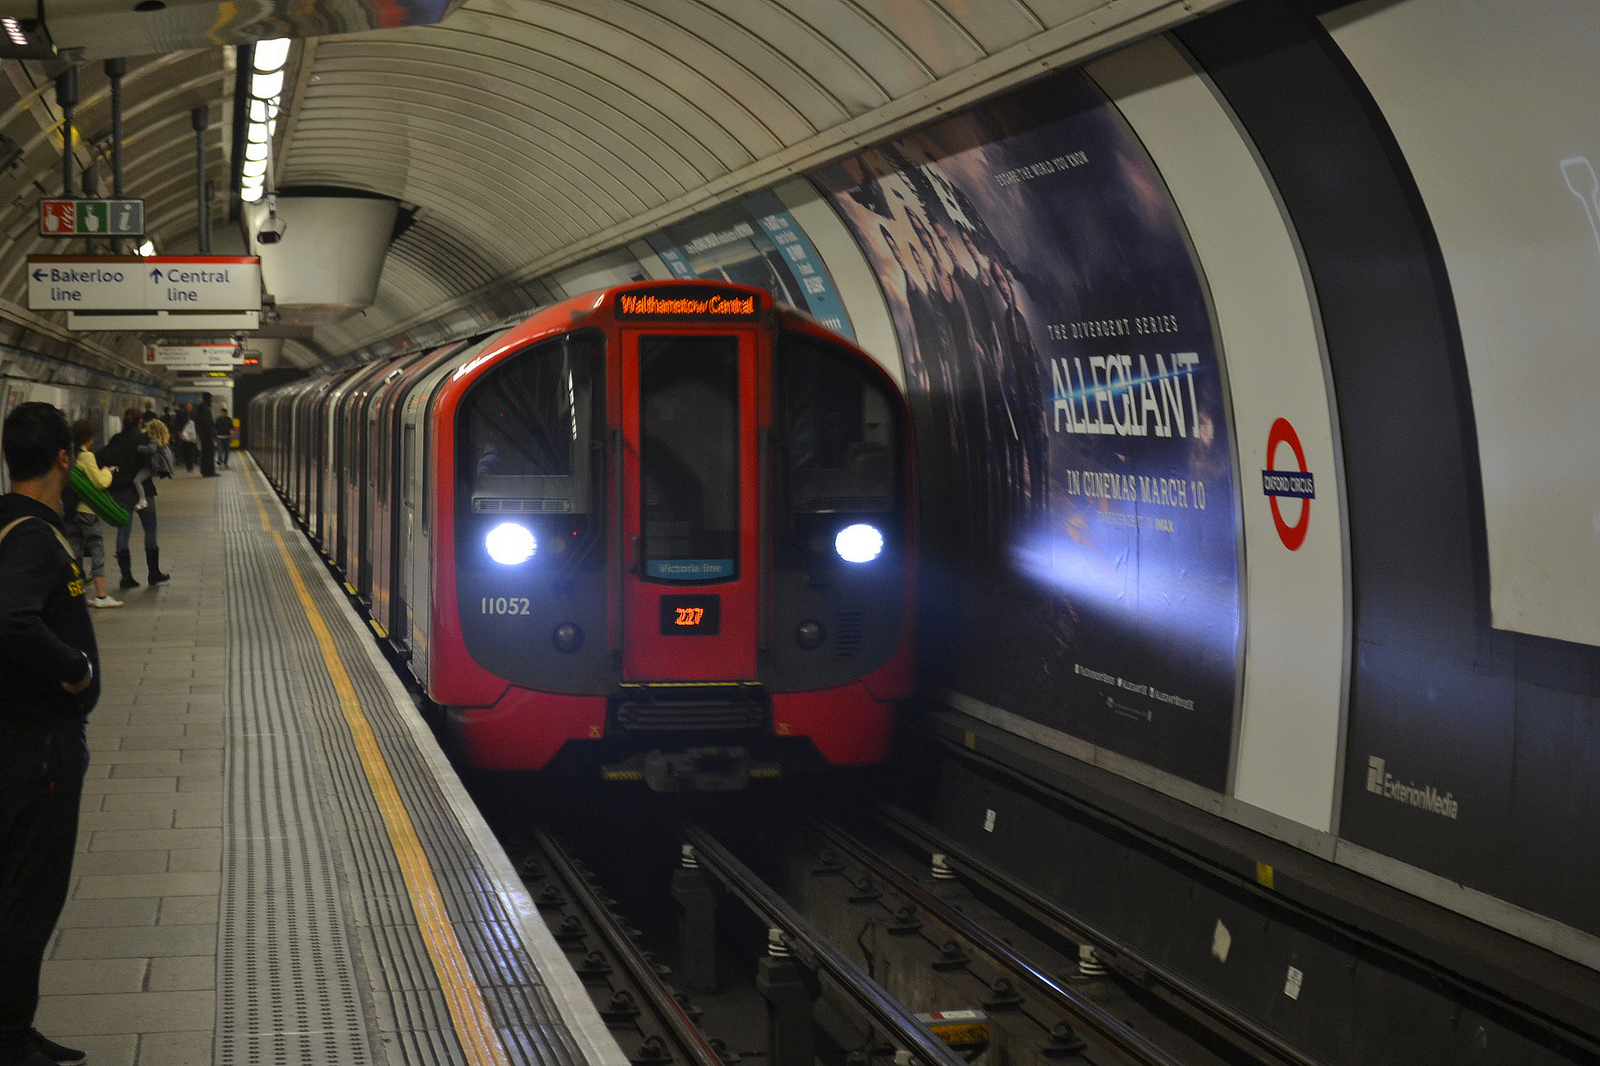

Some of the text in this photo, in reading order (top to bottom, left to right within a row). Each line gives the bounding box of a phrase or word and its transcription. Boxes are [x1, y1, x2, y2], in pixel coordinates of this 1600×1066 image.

[1016, 166, 1035, 181] THE
[1031, 161, 1055, 176] WORLD
[1052, 156, 1069, 171] YOU
[1065, 151, 1089, 166] KNOW
[51, 269, 124, 283] Bakerloo
[167, 269, 229, 283] Central
[51, 287, 82, 301] line
[167, 287, 198, 301] line
[621, 294, 754, 314] Walthamstow Central
[1047, 315, 1179, 341] THE DIVERGENT SERIES
[1050, 352, 1201, 439] ALLEGIANT
[1066, 469, 1206, 510] IN CINEMAS MARCH 10
[1264, 475, 1313, 493] OXFORD CIRCUS
[660, 563, 722, 573] Victoria line
[481, 597, 531, 616] 11052
